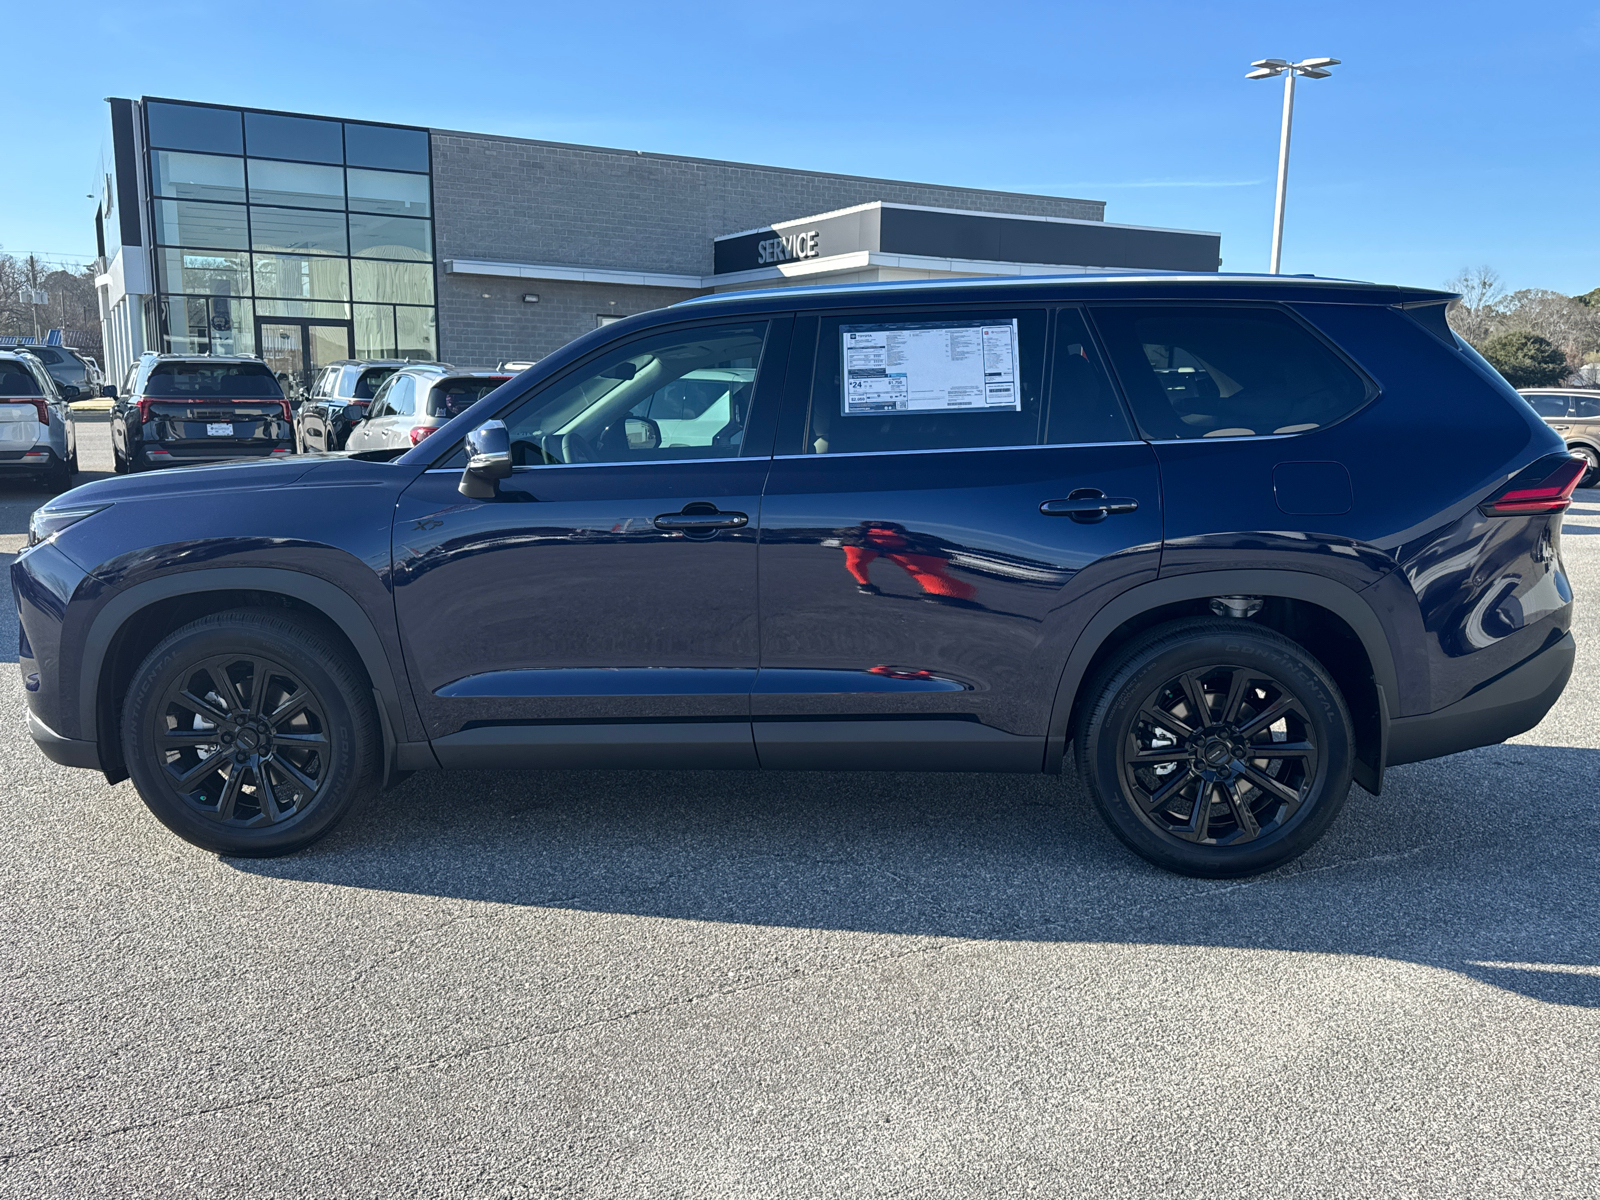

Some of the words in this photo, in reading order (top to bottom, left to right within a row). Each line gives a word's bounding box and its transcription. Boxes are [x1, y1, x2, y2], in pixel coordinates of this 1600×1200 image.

[758, 231, 817, 264] SERVICE
[852, 381, 862, 389] 24
[130, 651, 182, 760] CONTINENTAL
[1225, 644, 1335, 723] CONTINENTAL
